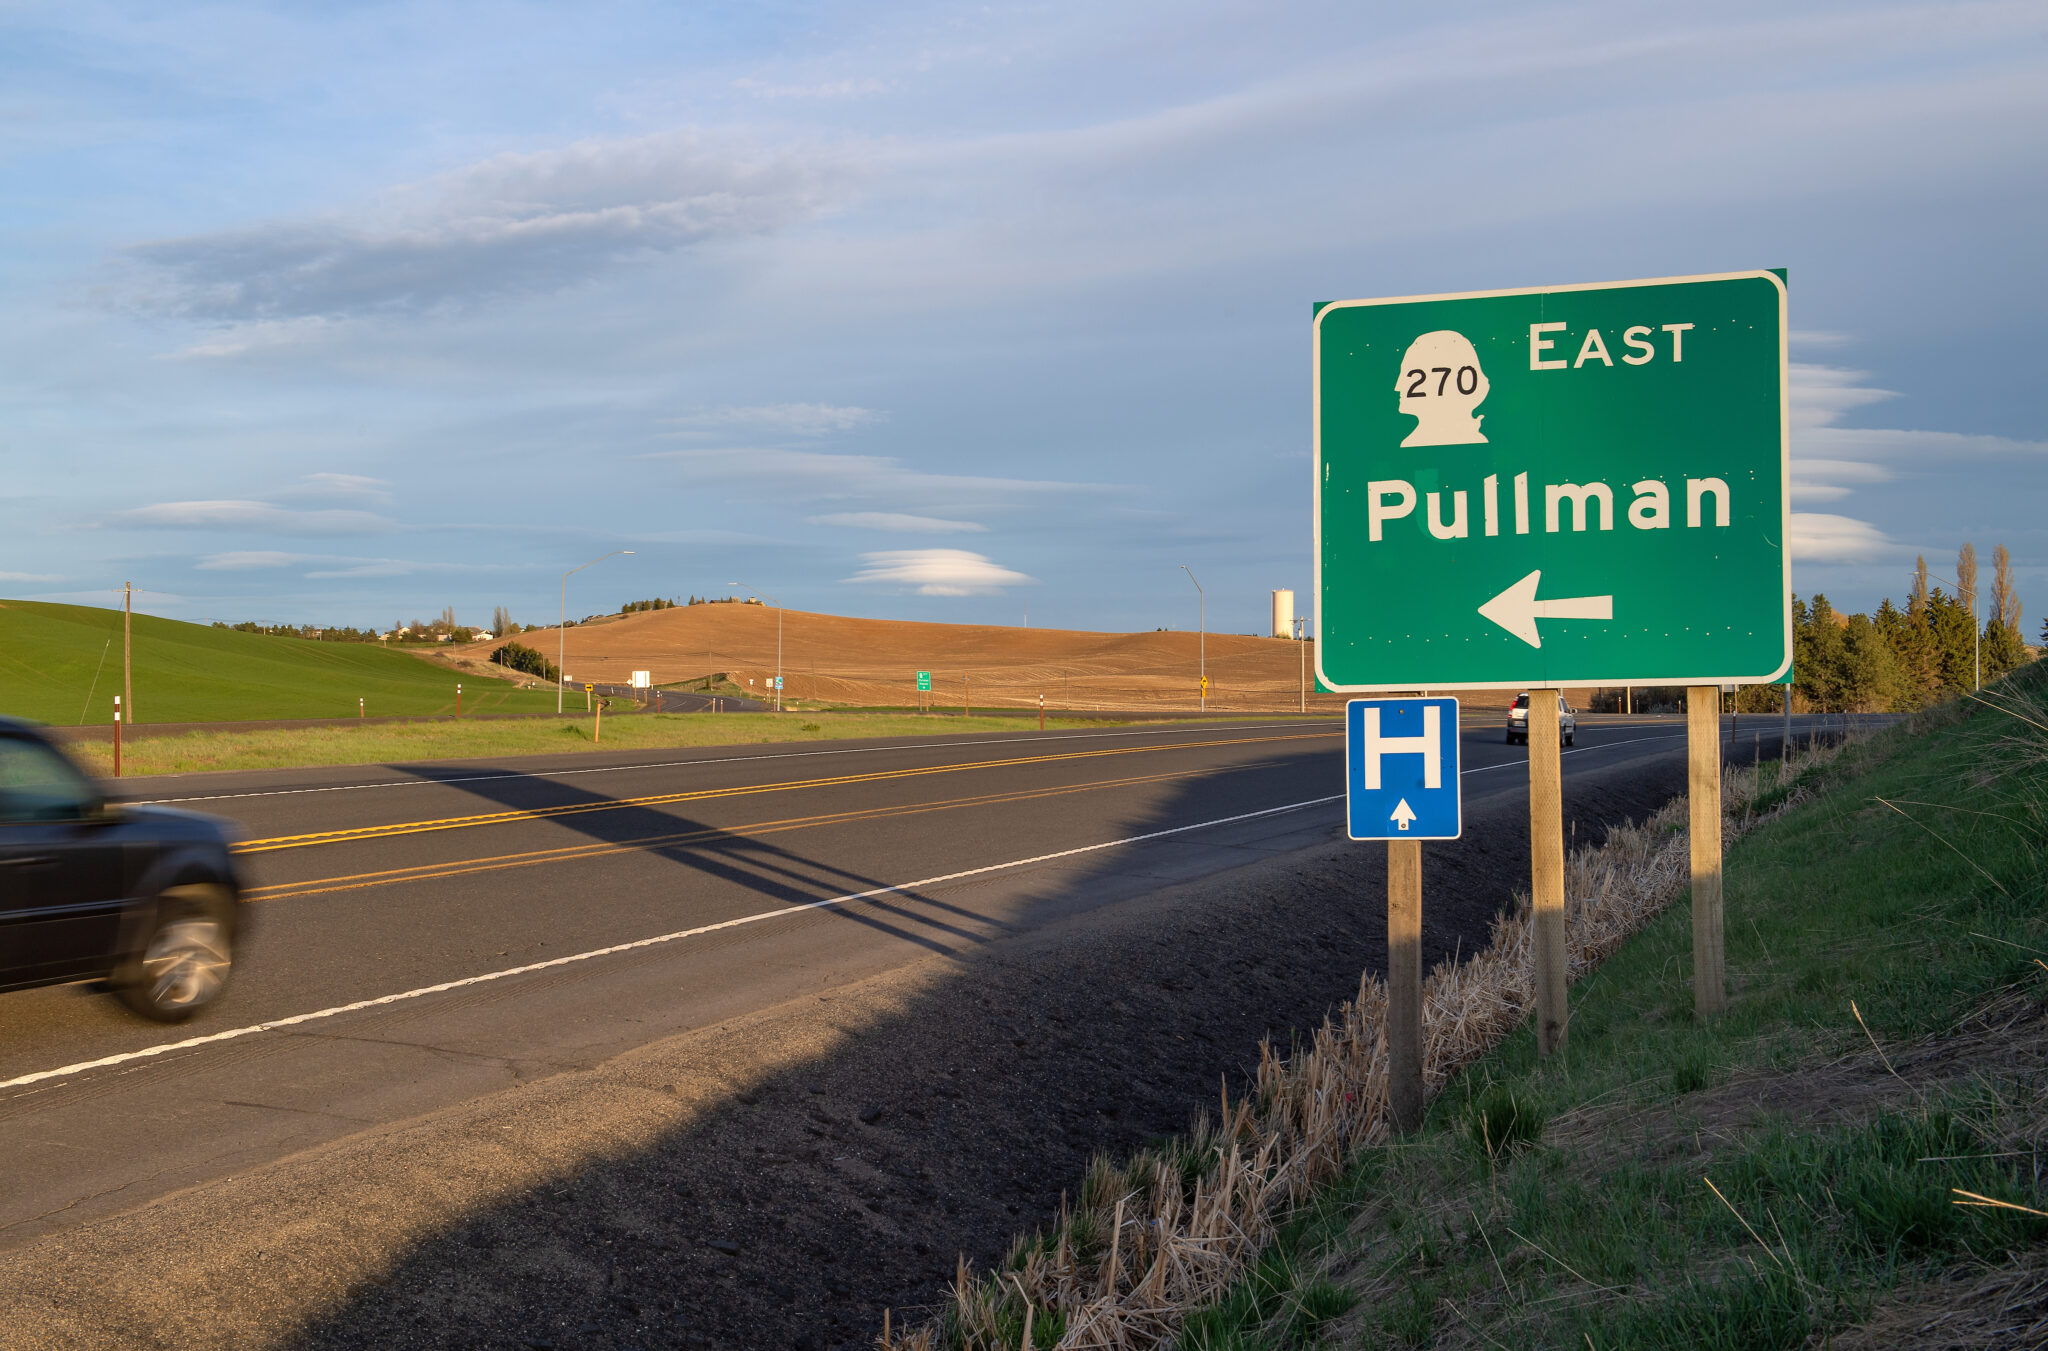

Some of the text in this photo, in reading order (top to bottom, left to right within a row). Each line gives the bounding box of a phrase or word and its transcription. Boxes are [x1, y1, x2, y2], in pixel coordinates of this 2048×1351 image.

[1529, 322, 1694, 370] EAST
[1406, 364, 1478, 398] 270
[1367, 471, 1730, 542] Pullman
[1363, 706, 1442, 790] H
